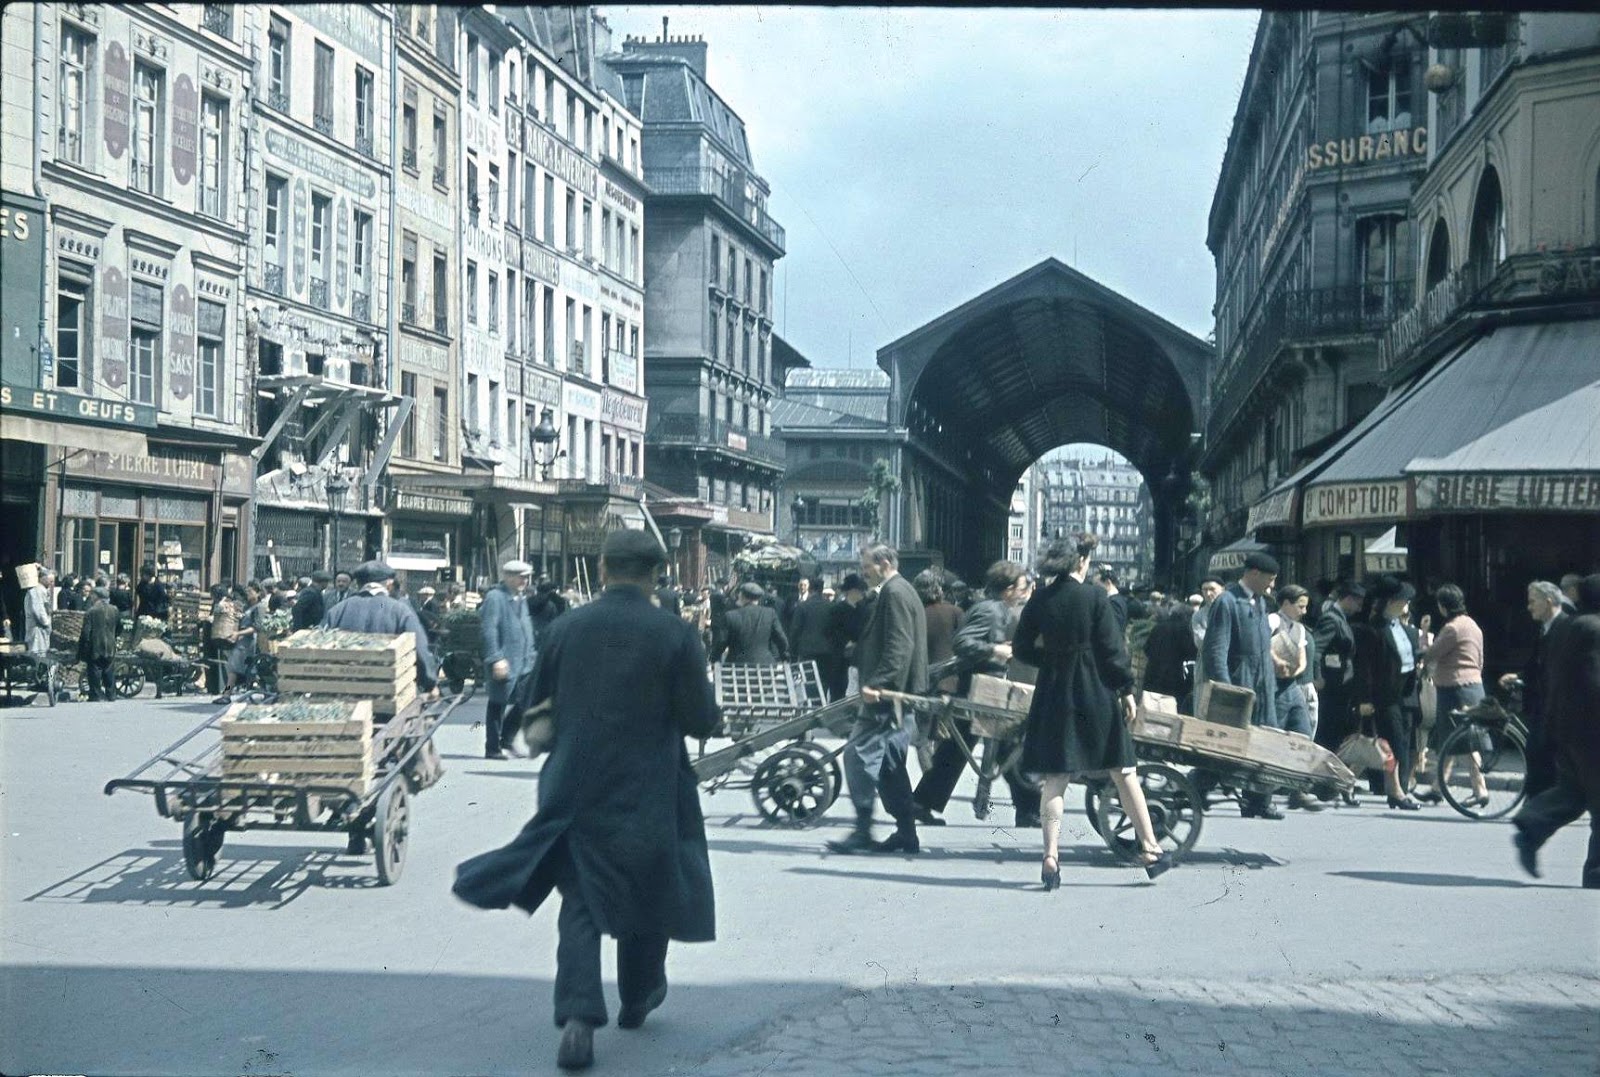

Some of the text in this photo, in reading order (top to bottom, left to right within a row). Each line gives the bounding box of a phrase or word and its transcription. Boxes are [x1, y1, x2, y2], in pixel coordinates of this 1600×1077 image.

[32, 391, 58, 410] ET
[78, 398, 135, 422] ŒUFS
[1318, 485, 1399, 516] COMPTOIR
